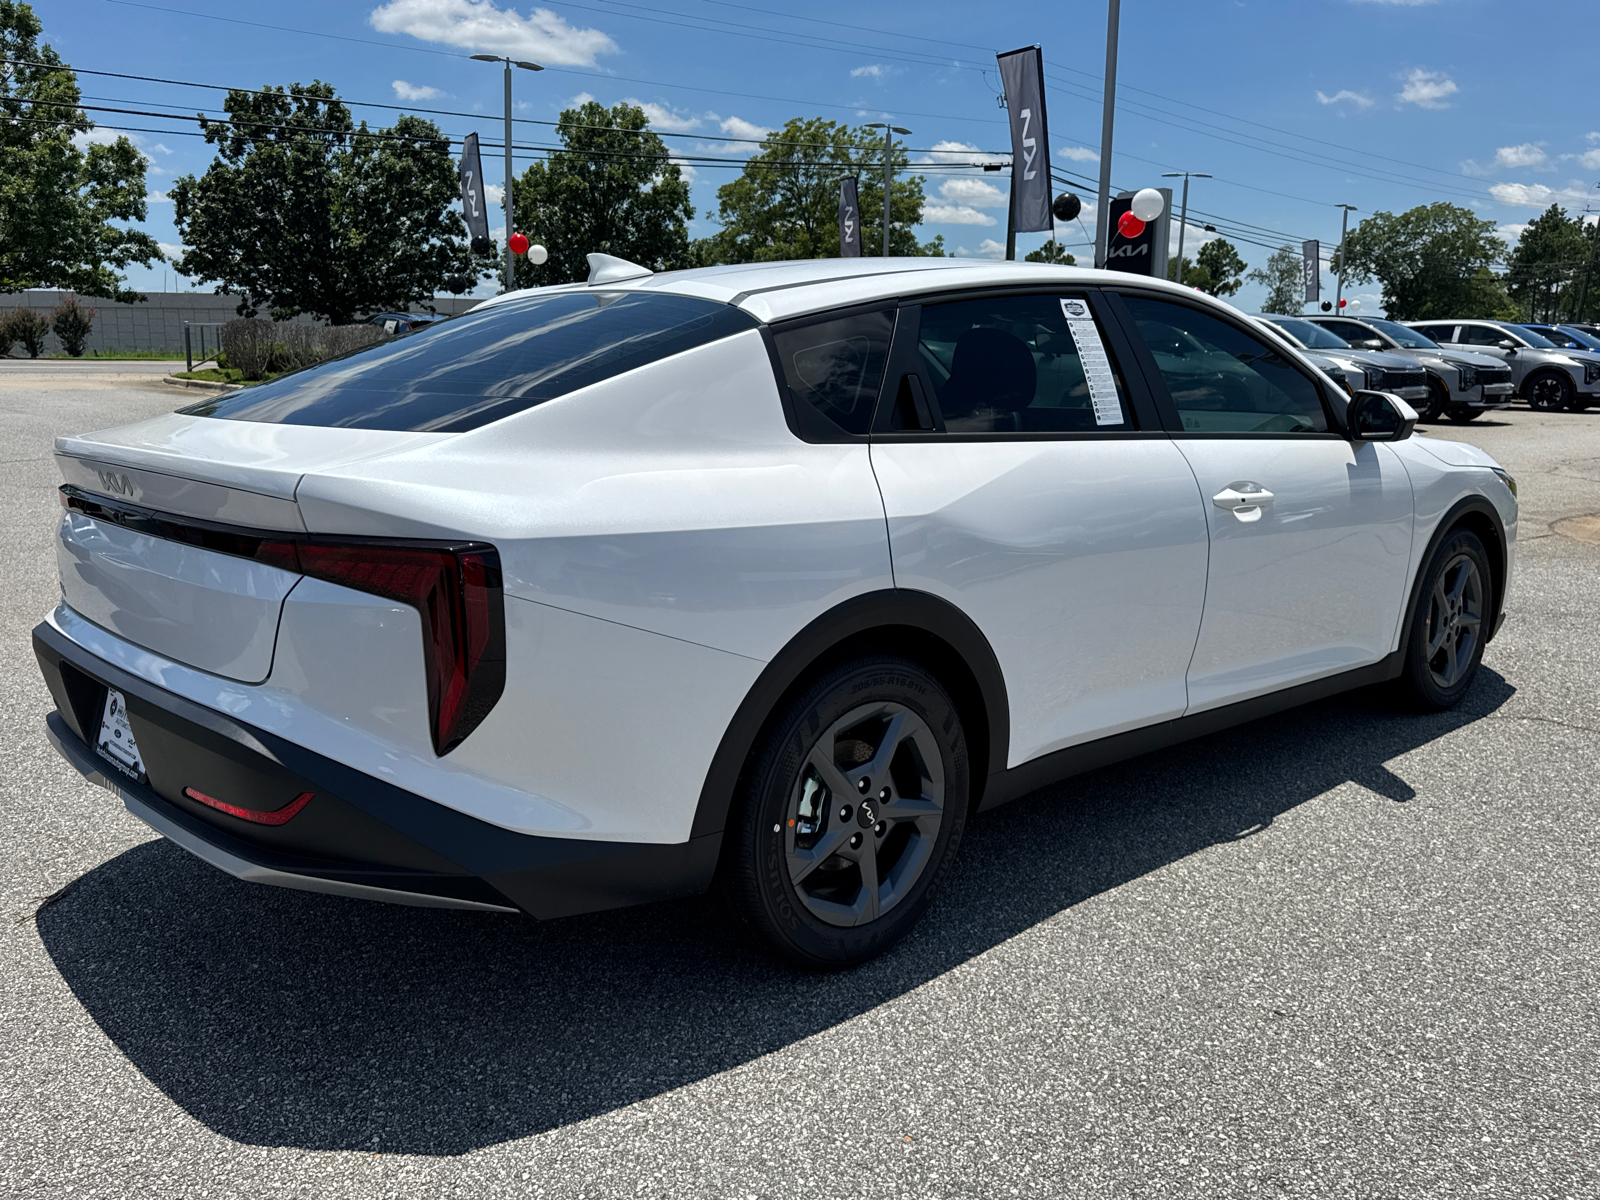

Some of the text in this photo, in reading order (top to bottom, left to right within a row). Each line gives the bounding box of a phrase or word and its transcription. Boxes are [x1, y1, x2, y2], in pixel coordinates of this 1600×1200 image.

[1109, 243, 1148, 258] KIA
[97, 469, 134, 497] KIA
[850, 676, 885, 695] 205/55
[887, 676, 906, 687] R16
[862, 801, 875, 825] KIA
[926, 818, 963, 900] KUMHO
